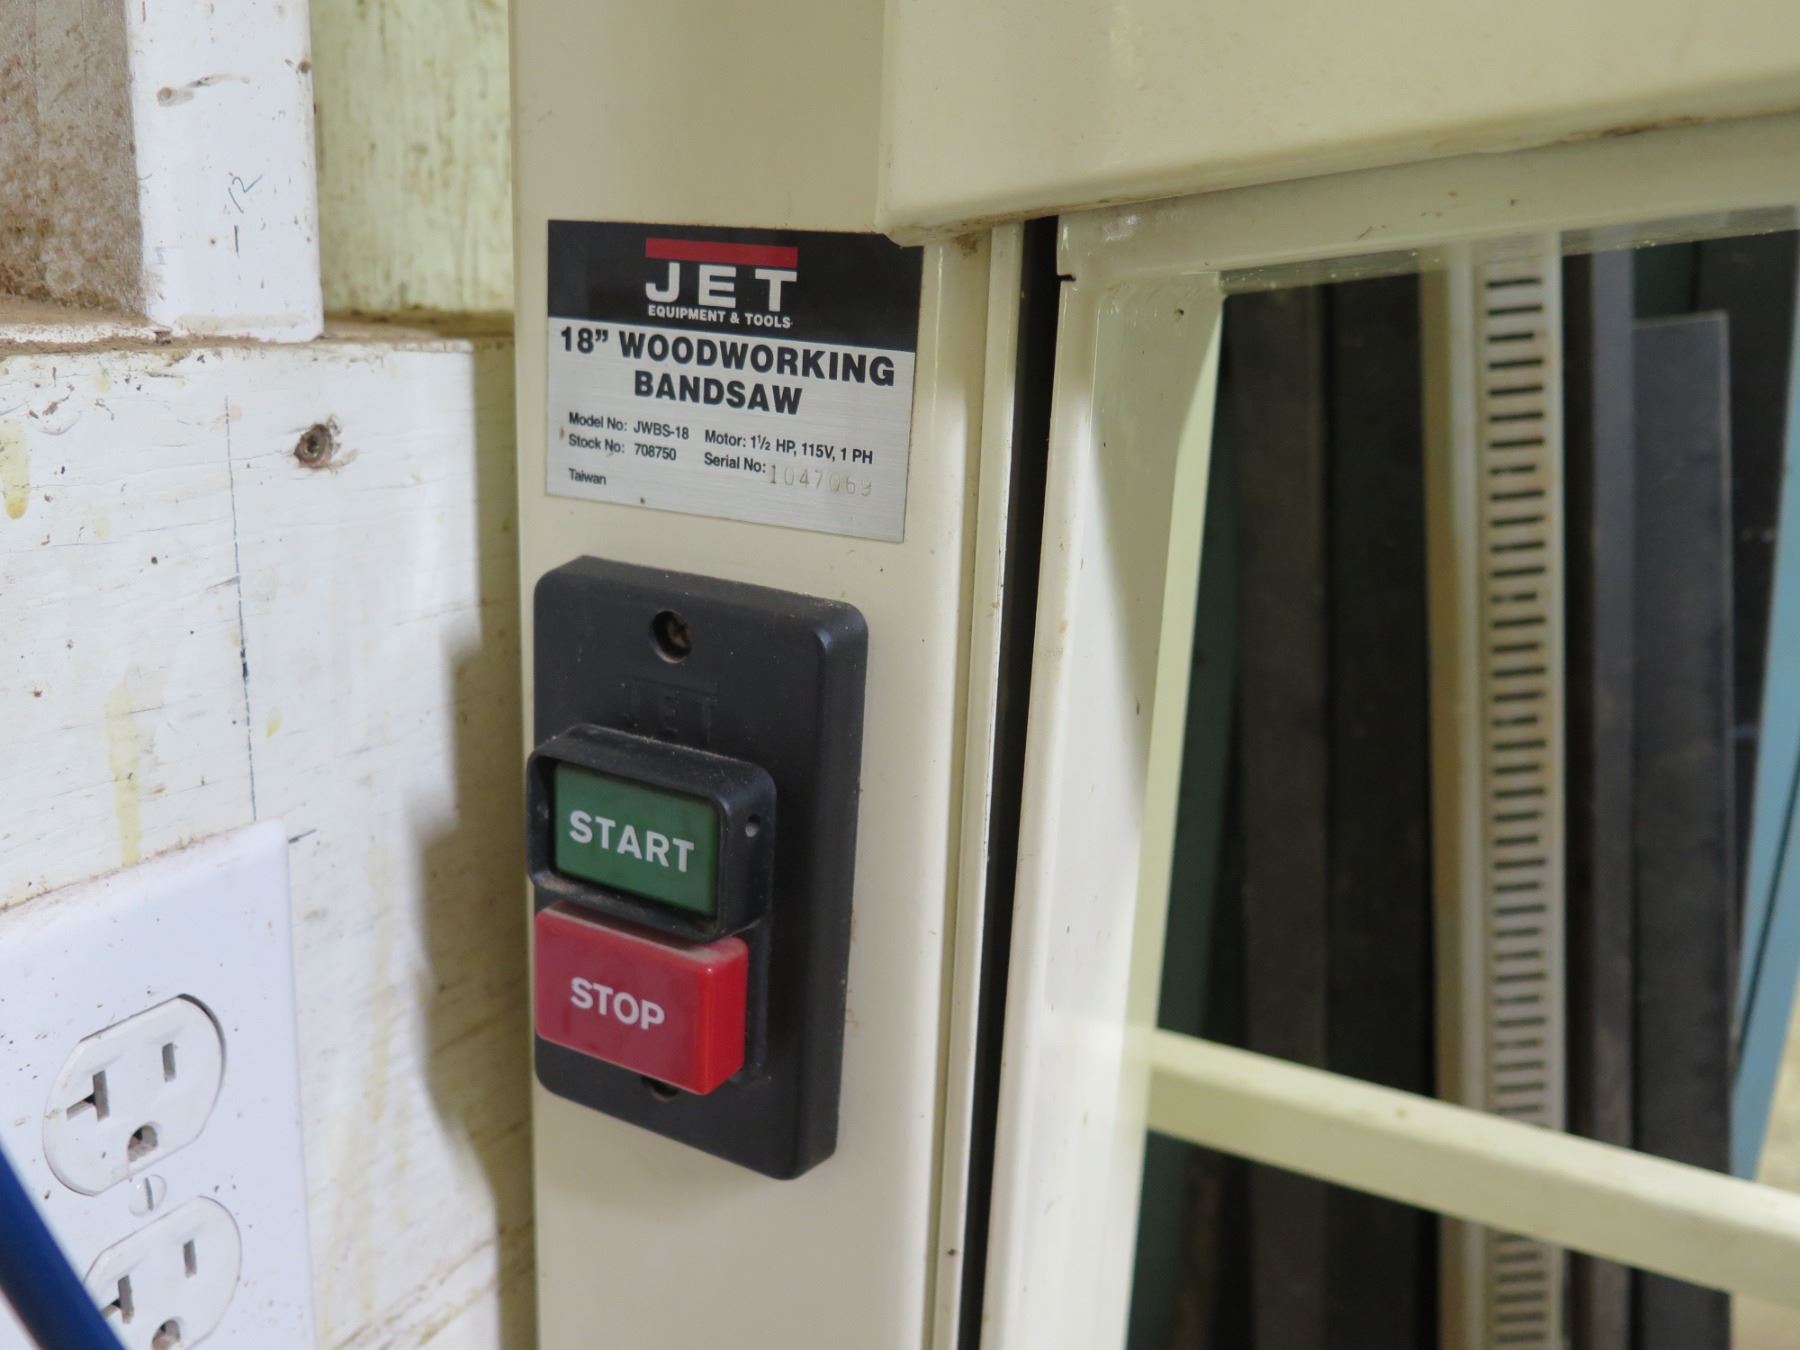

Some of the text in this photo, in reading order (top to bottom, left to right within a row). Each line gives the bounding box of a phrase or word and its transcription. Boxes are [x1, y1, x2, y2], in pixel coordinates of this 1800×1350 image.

[645, 261, 798, 312] JET
[648, 305, 791, 329] EQUIPMENT & TOOLS
[619, 330, 895, 387] WOODWORKING
[634, 370, 802, 415] BANDSAW
[569, 411, 690, 440] Model No: JWBS-18
[569, 433, 676, 461] Stock No: 708750
[704, 452, 740, 470] Serial
[744, 456, 766, 473] No:
[705, 429, 747, 448] Motor:
[776, 439, 797, 456] HP,
[801, 442, 836, 462] 115V,
[841, 447, 847, 461] 1
[852, 449, 873, 464] PH
[568, 468, 607, 485] Taiwan
[569, 810, 695, 872] START
[570, 977, 665, 1030] STOP
